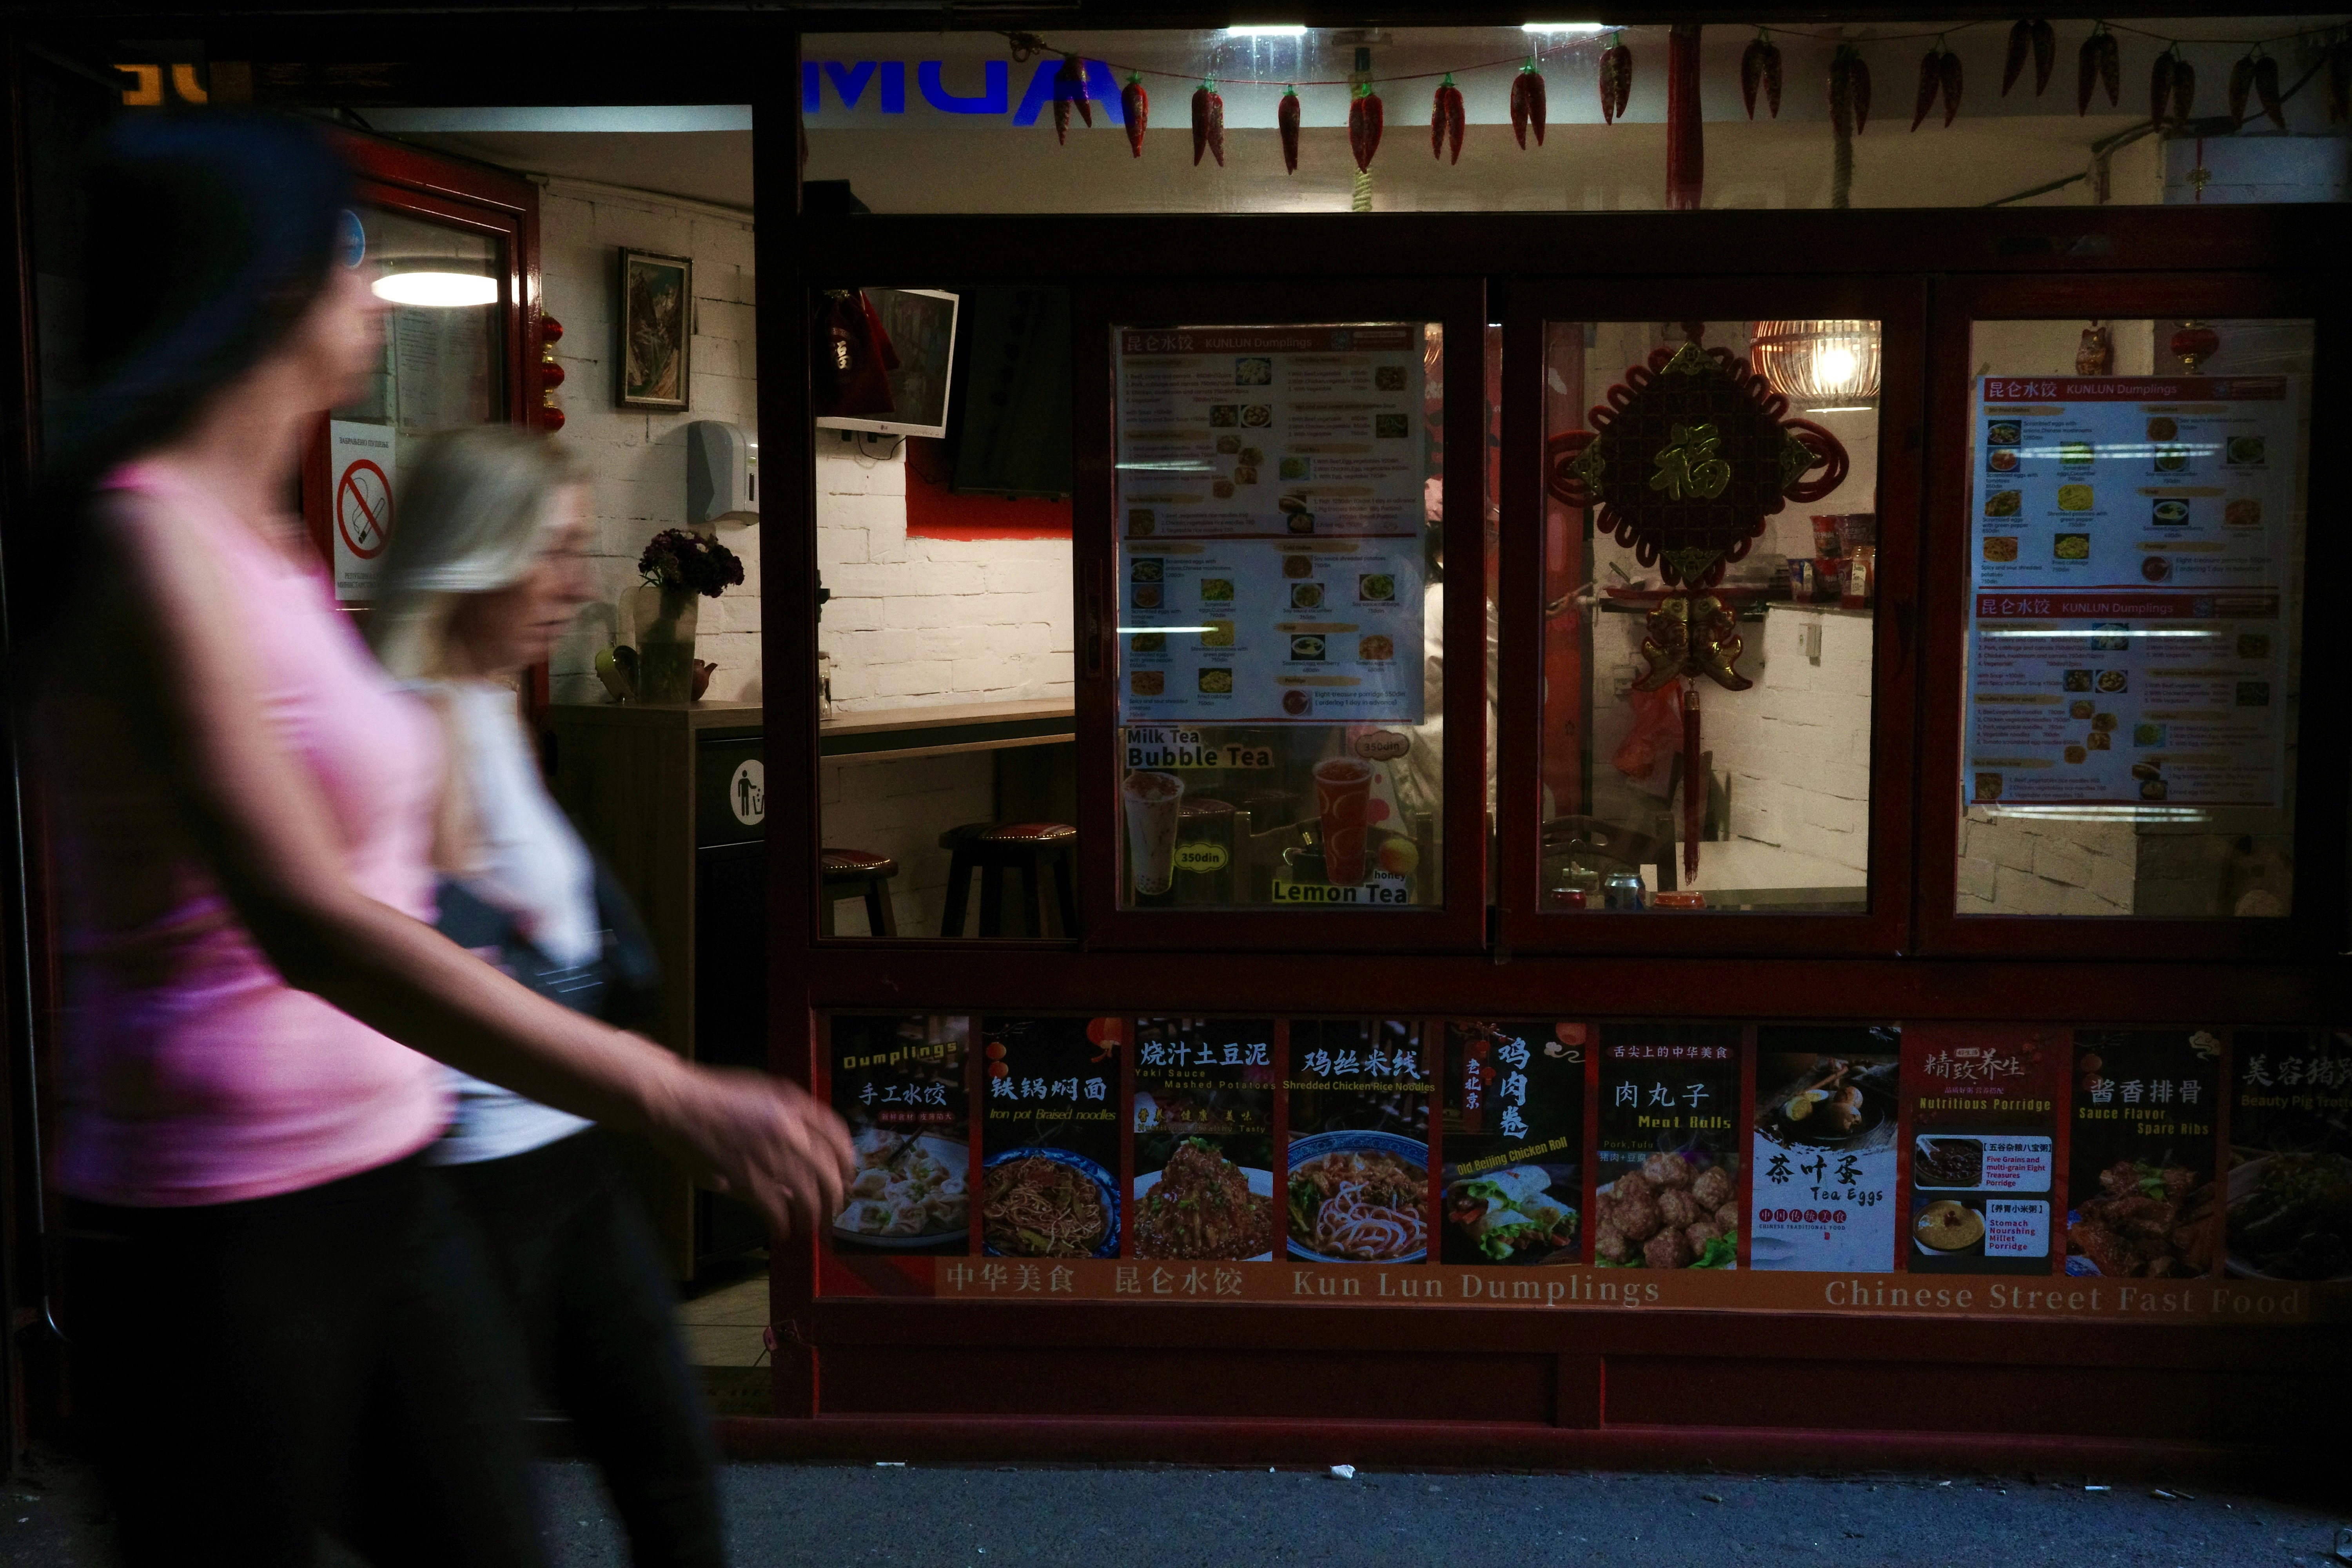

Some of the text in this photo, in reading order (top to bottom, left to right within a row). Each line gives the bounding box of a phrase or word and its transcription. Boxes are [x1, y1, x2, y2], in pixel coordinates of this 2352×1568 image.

[1127, 335, 1312, 351] 昆仑水饺 KUNLUN Dumplings
[1989, 381, 2177, 397] 昆仑水饺 KUNLUN Dumplings
[1649, 423, 1730, 501] 福
[1982, 599, 2174, 614] 昆仑水饺 KUNLUN Dumplings
[1128, 729, 1200, 744] Milk Tea
[1365, 741, 1400, 751] 350din
[1128, 747, 1270, 766] Bubble Tea
[1181, 853, 1219, 863] 350din
[1374, 870, 1406, 881] honey
[1274, 882, 1407, 903] Lemon Tea
[844, 1042, 957, 1069] Dumplings
[1140, 1040, 1270, 1067] 烧汁土豆泥
[1613, 1045, 1727, 1058] 舌尖上的中华美食
[1301, 1048, 1421, 1080] 鸡丝米线
[1924, 1048, 2025, 1080] 精致养生
[1135, 1069, 1205, 1078] Yaki Sauce
[991, 1076, 1107, 1102] 铁锅焖面
[1165, 1080, 1276, 1090] Mashed Potatoes
[1283, 1080, 1435, 1092] Shredded Chicken Rice Noodles
[1465, 1058, 1481, 1110] 老北京
[1498, 1036, 1530, 1140] 鸡肉卷
[2090, 1079, 2201, 1104] 酱香排骨
[858, 1082, 947, 1106] 手工水饺
[1615, 1080, 1710, 1109] 肉丸子
[1920, 1098, 2051, 1112] Nutritious Porridge
[2241, 1095, 2288, 1110] Beauty
[2291, 1096, 2314, 1111] Pig
[990, 1108, 1117, 1122] Iron pot Braised noodles
[1138, 1108, 1252, 1123] 营养 健康 美味
[2079, 1107, 2167, 1120] Sauce Flavor
[1239, 1125, 1266, 1133] Tasty
[1638, 1115, 1731, 1129] Meat Balls
[2137, 1122, 2209, 1136] Spare Ribs
[1457, 1136, 1568, 1176] Old Beijing Chicken Roll
[1766, 1153, 1863, 1185] 茶叶蛋
[1810, 1187, 1882, 1207] Tea Eggs
[1760, 1209, 1846, 1223] 中国传统美食
[947, 1262, 1659, 1308] 中华美食 昆仑水饺 Kun Lun Dumplings
[1825, 1279, 2302, 1314] Chinese Street Fast Food
